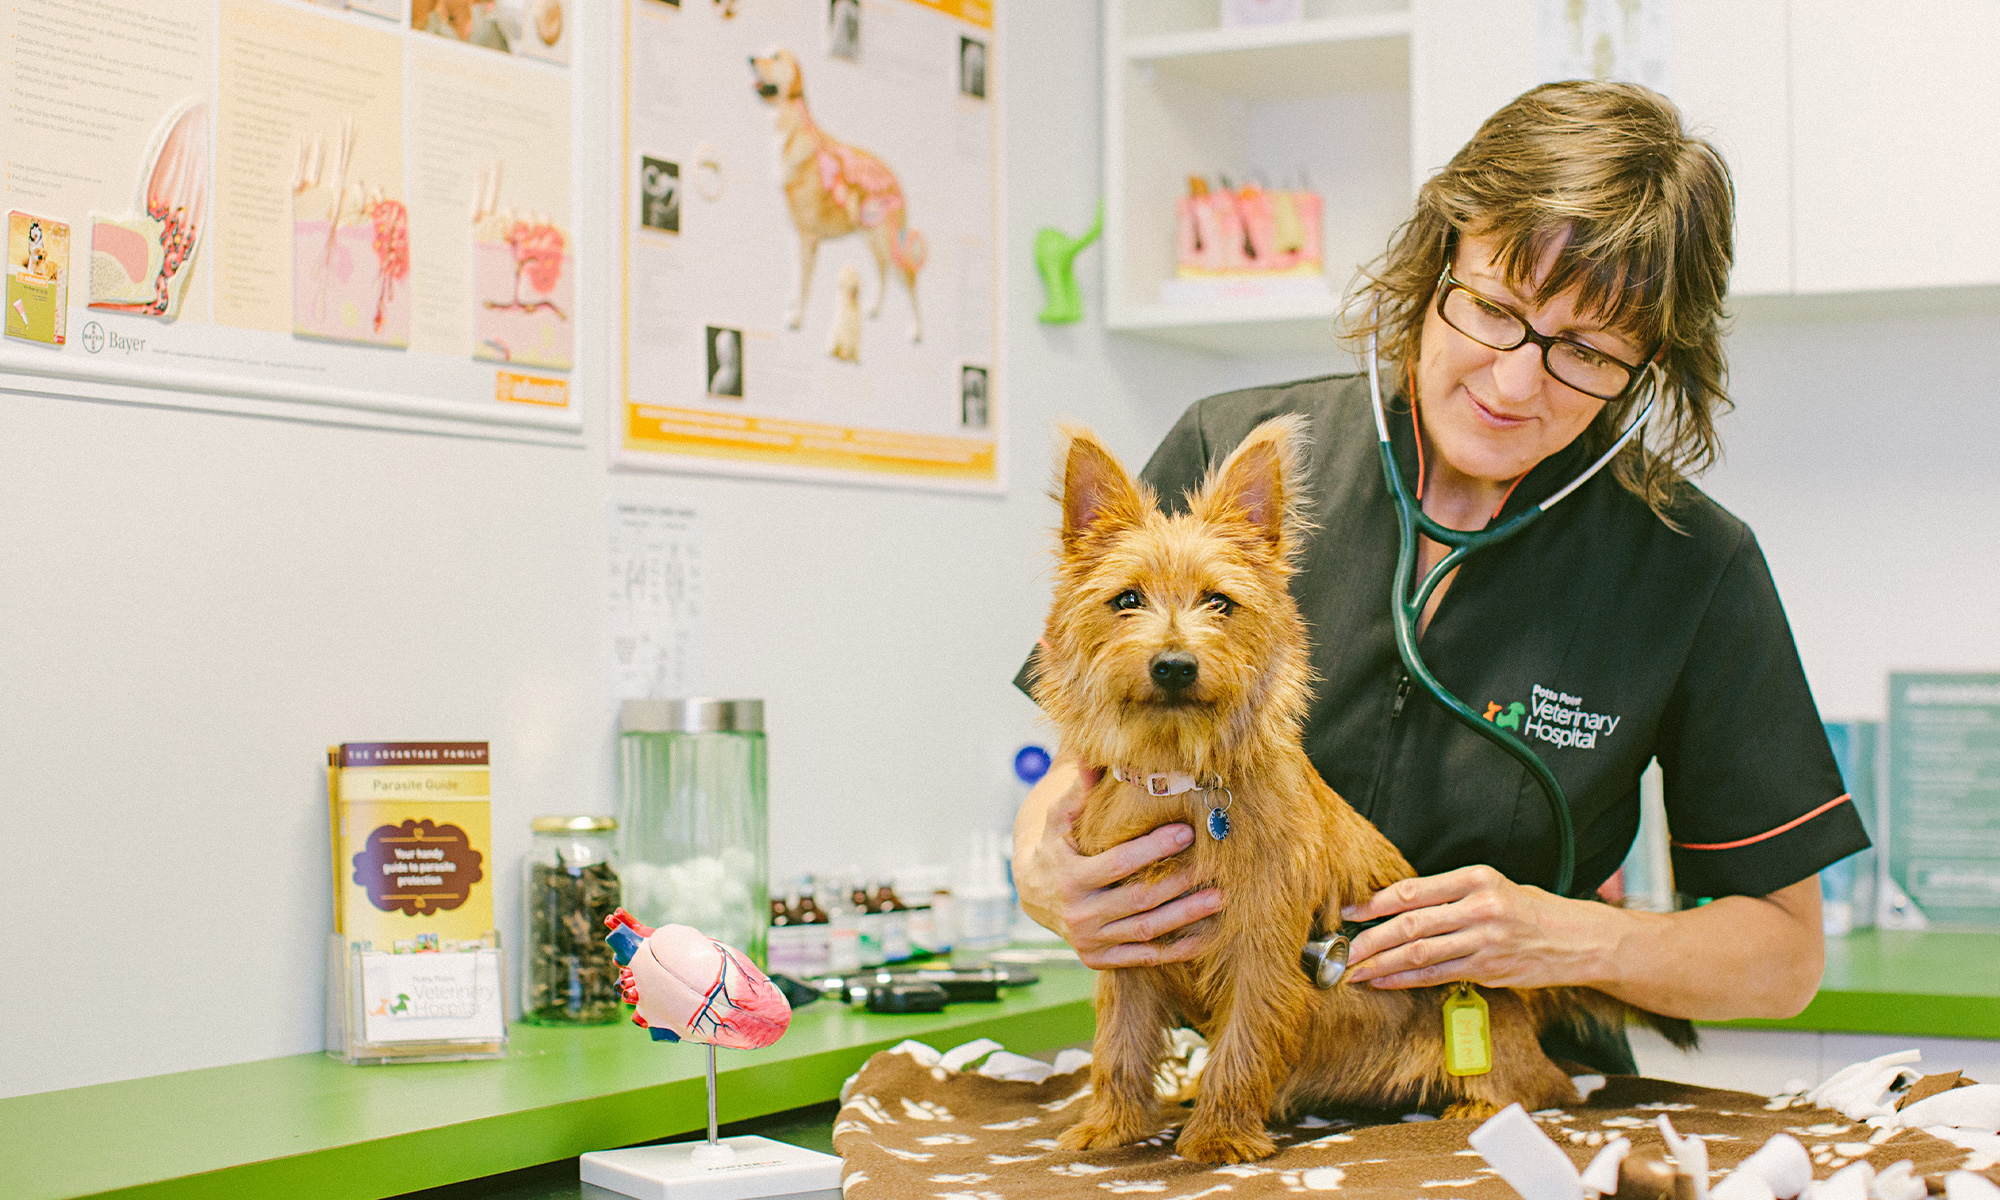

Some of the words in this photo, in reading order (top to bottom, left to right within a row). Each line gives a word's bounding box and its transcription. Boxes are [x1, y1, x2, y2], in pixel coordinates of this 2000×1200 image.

[109, 331, 146, 355] Bayer
[1532, 683, 1558, 701] Potts
[1559, 692, 1583, 707] Point
[1531, 694, 1621, 737] Veterinary
[1524, 714, 1597, 750] Hospital
[349, 750, 370, 759] THE
[375, 749, 438, 759] ADVANTAGE
[443, 749, 483, 759] FAMILY
[373, 779, 423, 791] Parasite
[426, 778, 459, 791] Guide
[394, 848, 416, 860] Your
[416, 848, 445, 862] handy
[382, 861, 409, 876] guide
[409, 862, 419, 873] to
[419, 861, 457, 875] parasite
[397, 875, 444, 888] protection
